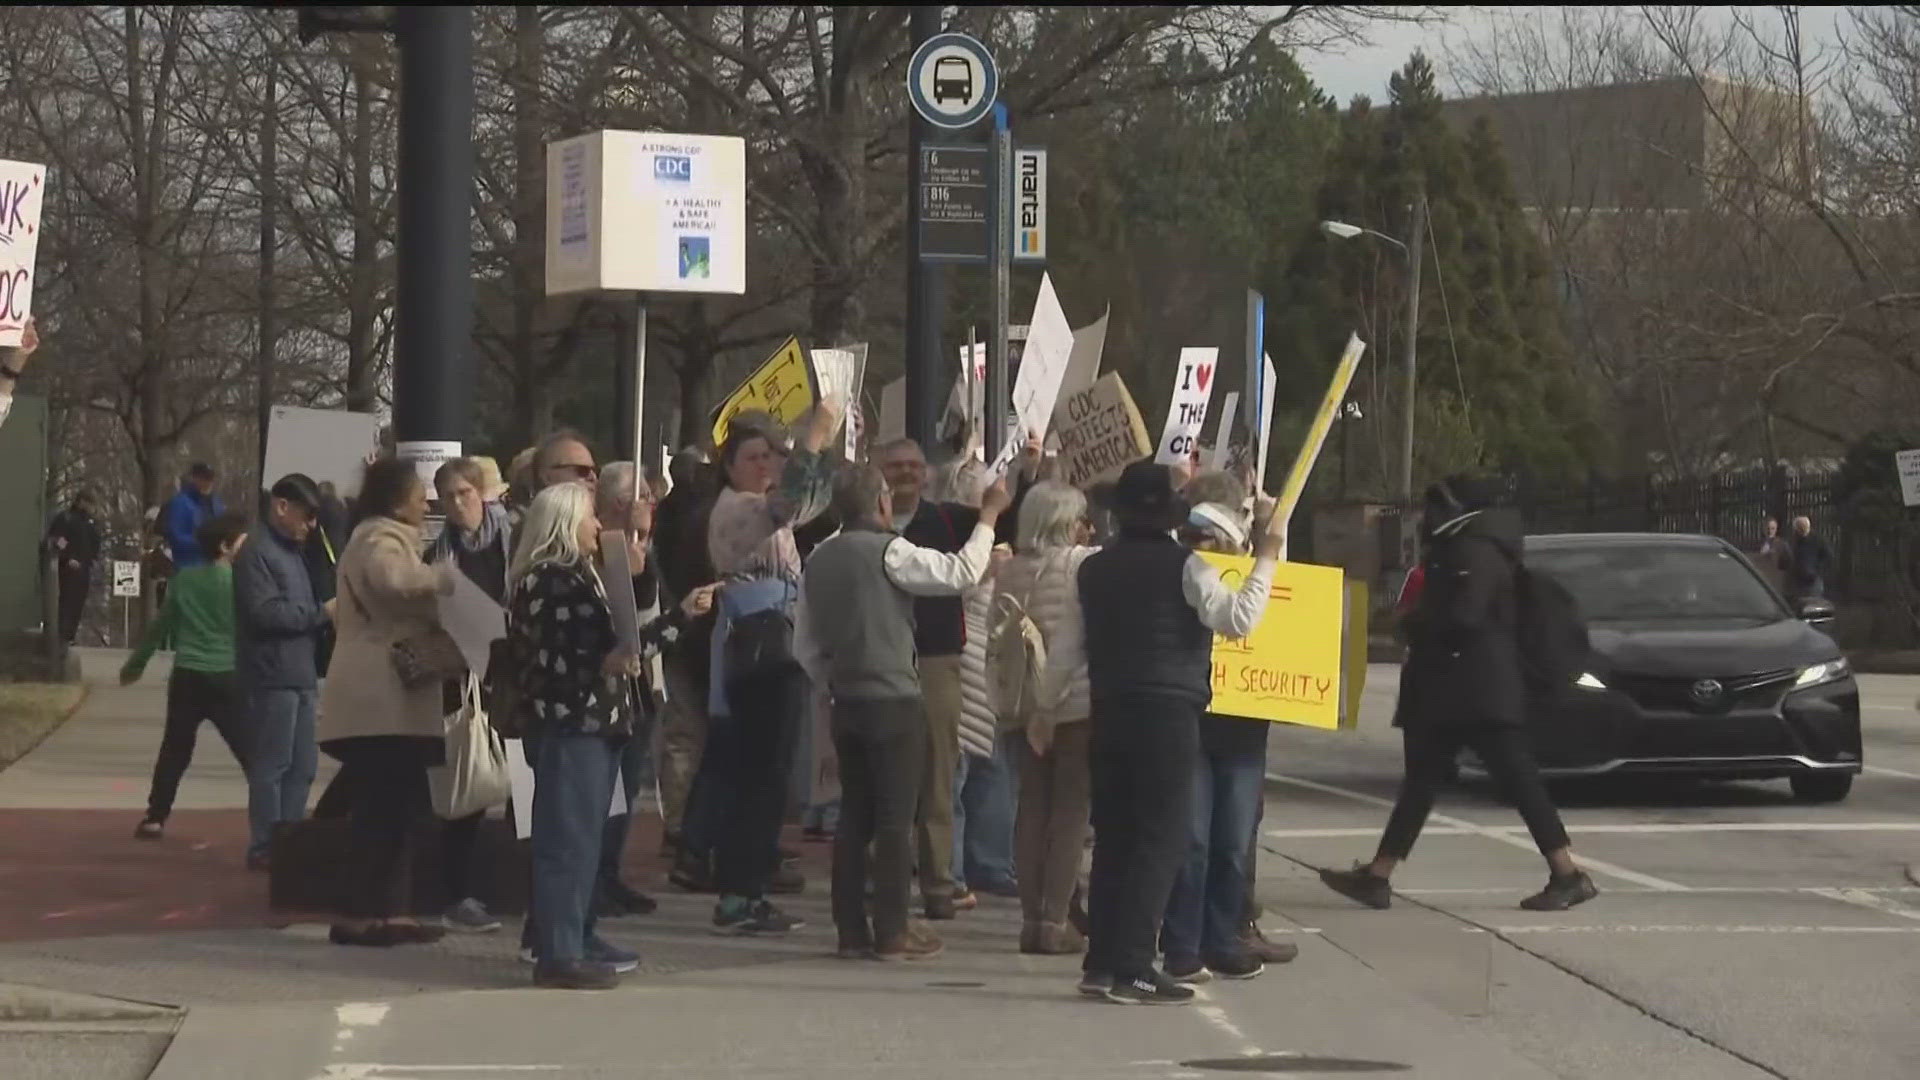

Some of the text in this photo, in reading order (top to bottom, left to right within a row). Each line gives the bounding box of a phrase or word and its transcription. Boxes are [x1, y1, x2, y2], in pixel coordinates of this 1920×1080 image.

[655, 158, 690, 177] CDC
[931, 151, 938, 166] 6
[931, 186, 950, 201] 816
[1022, 155, 1038, 228] marta
[683, 199, 721, 208] HEALTHY
[687, 210, 709, 218] SAFE
[1181, 365, 1193, 390] I
[1068, 386, 1101, 422] CDC
[1059, 402, 1131, 455] PROTECTS
[1236, 665, 1331, 700] SECURITY
